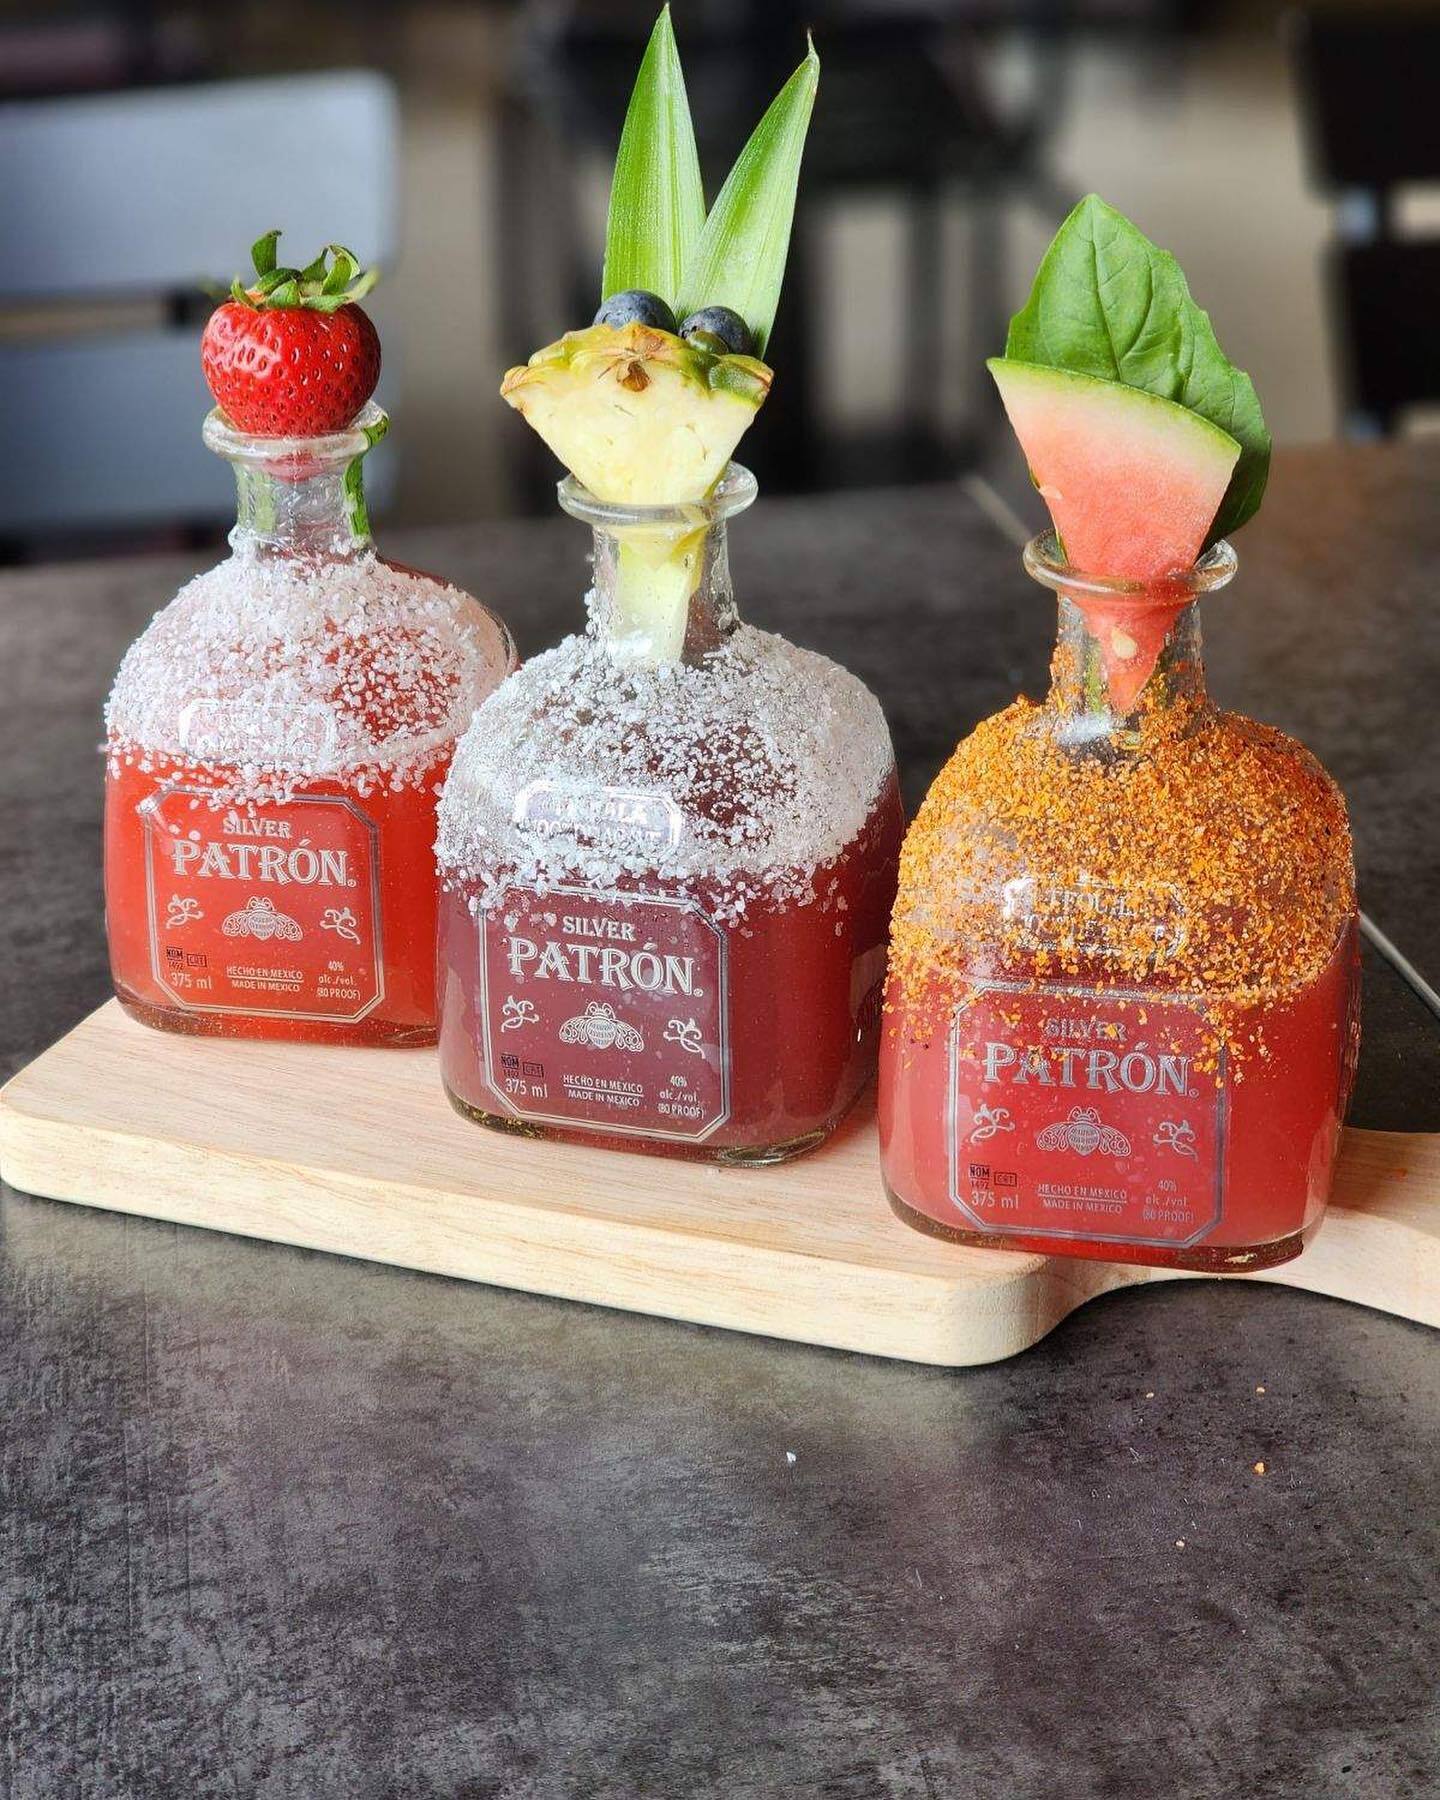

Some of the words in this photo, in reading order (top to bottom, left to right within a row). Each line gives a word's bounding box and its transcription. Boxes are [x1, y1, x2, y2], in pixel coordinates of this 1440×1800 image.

[222, 817, 292, 839] SILVER
[171, 838, 348, 887] PATRÓN
[562, 915, 637, 941] SILVER
[226, 965, 255, 976] HECHO
[257, 967, 268, 977] EN
[270, 969, 303, 980] MEXICO
[328, 960, 344, 971] 40%
[507, 937, 696, 996] PATRÓN
[171, 972, 192, 988] 375
[196, 975, 212, 990] ml
[232, 980, 256, 990] MADE
[257, 981, 267, 990] IN
[268, 982, 300, 992] MEXICO
[1044, 1018, 1127, 1041] SILVER
[505, 1078, 527, 1095] 375
[531, 1083, 548, 1098] ml
[563, 1074, 593, 1086] HECHO
[595, 1078, 607, 1089] EN
[609, 1080, 643, 1093] MEXICO
[671, 1075, 688, 1087] 40%
[568, 1089, 594, 1101] MADE
[595, 1093, 605, 1102] IN
[607, 1095, 640, 1106] MEXICO
[970, 1167, 990, 1178] NOM
[1038, 1183, 1072, 1195] HECHO
[1074, 1186, 1087, 1197] EN
[1089, 1187, 1127, 1200] MEXICO
[1158, 1179, 1177, 1192] 40%
[971, 1191, 995, 1207] 375
[1001, 1194, 1019, 1209] ml
[1043, 1198, 1071, 1209] MADE
[1073, 1201, 1084, 1211] IN
[1086, 1203, 1122, 1214] MEXICO
